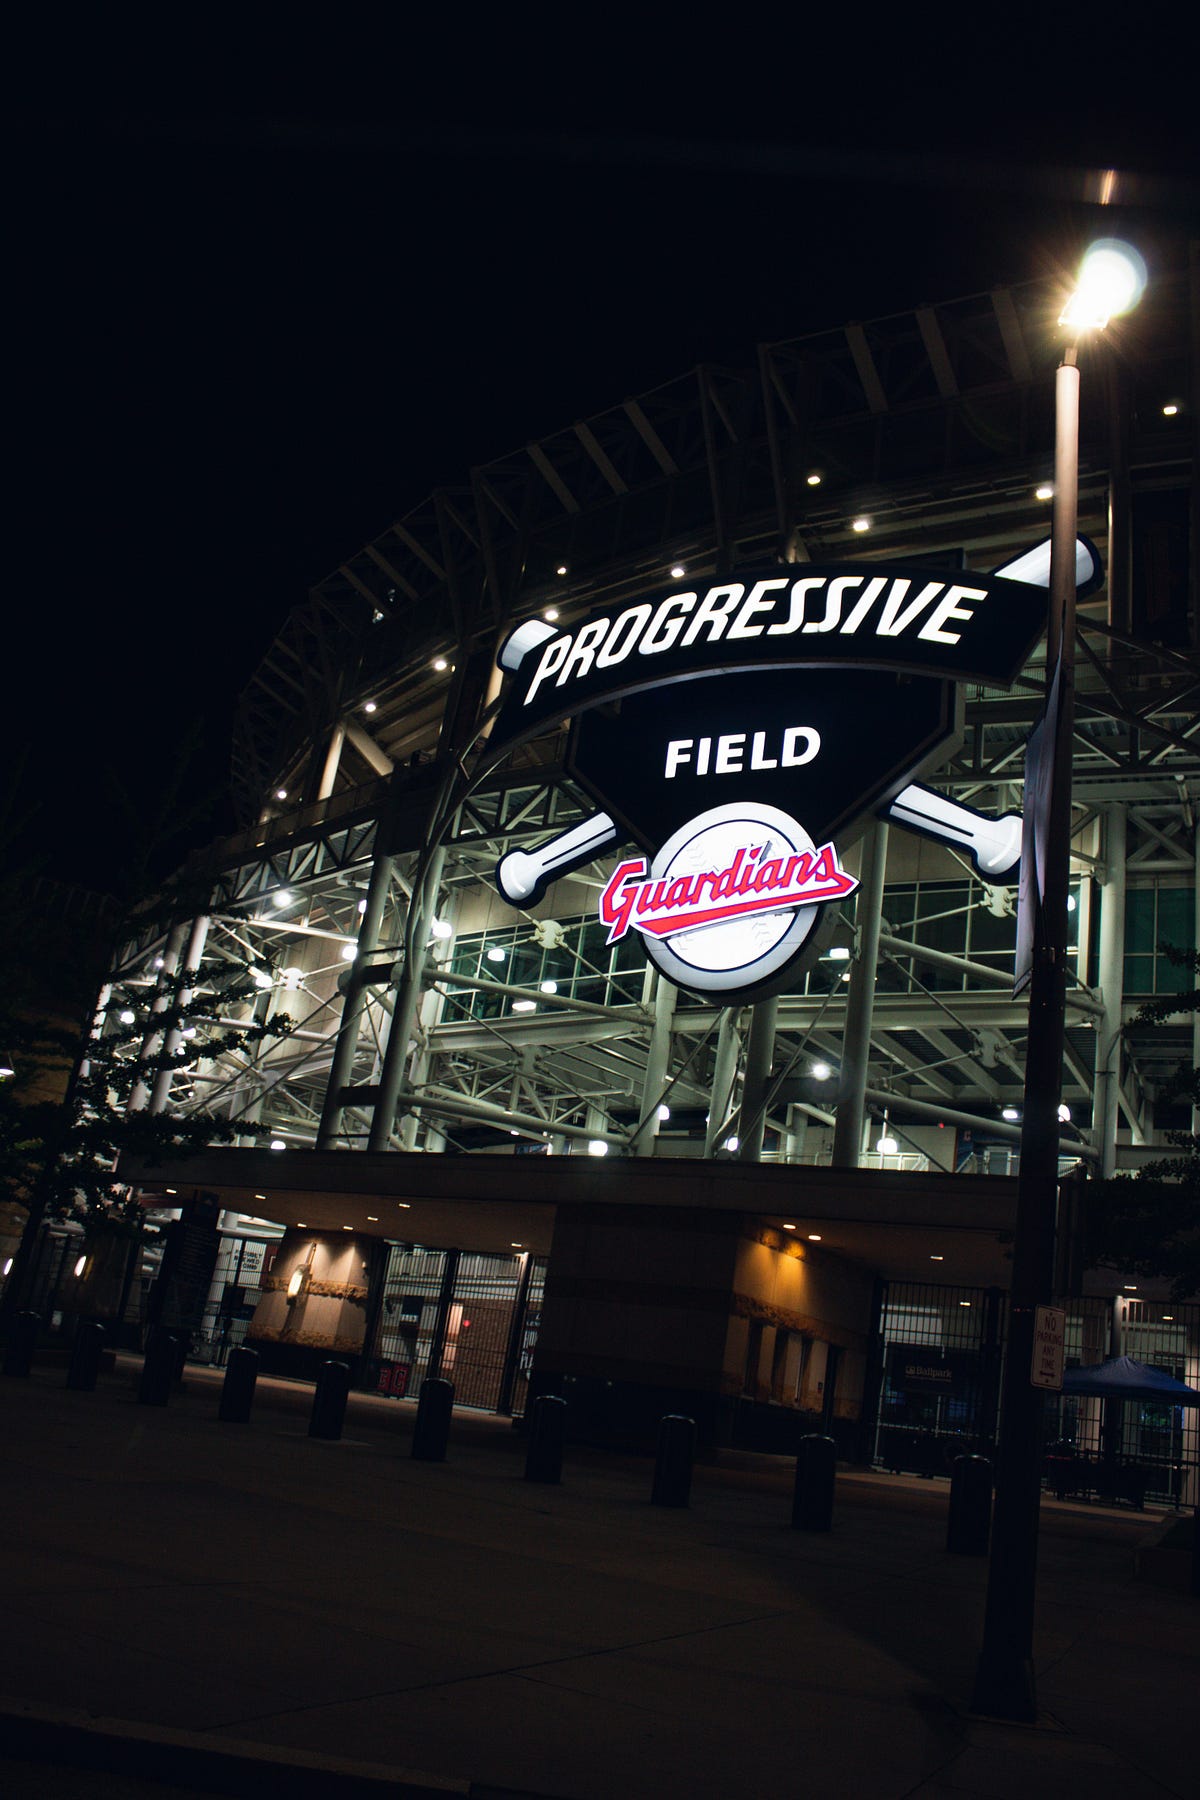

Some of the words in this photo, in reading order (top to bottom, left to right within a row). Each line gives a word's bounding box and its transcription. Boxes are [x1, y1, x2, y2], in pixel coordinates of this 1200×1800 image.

[523, 575, 988, 706] PROGRESSIVE
[664, 726, 821, 778] FIELD
[601, 844, 857, 941] Guardians
[1045, 1315, 1056, 1331] NO
[1037, 1330, 1062, 1345] PARKING
[1043, 1344, 1055, 1357] ANY
[1042, 1358, 1056, 1370] TIME
